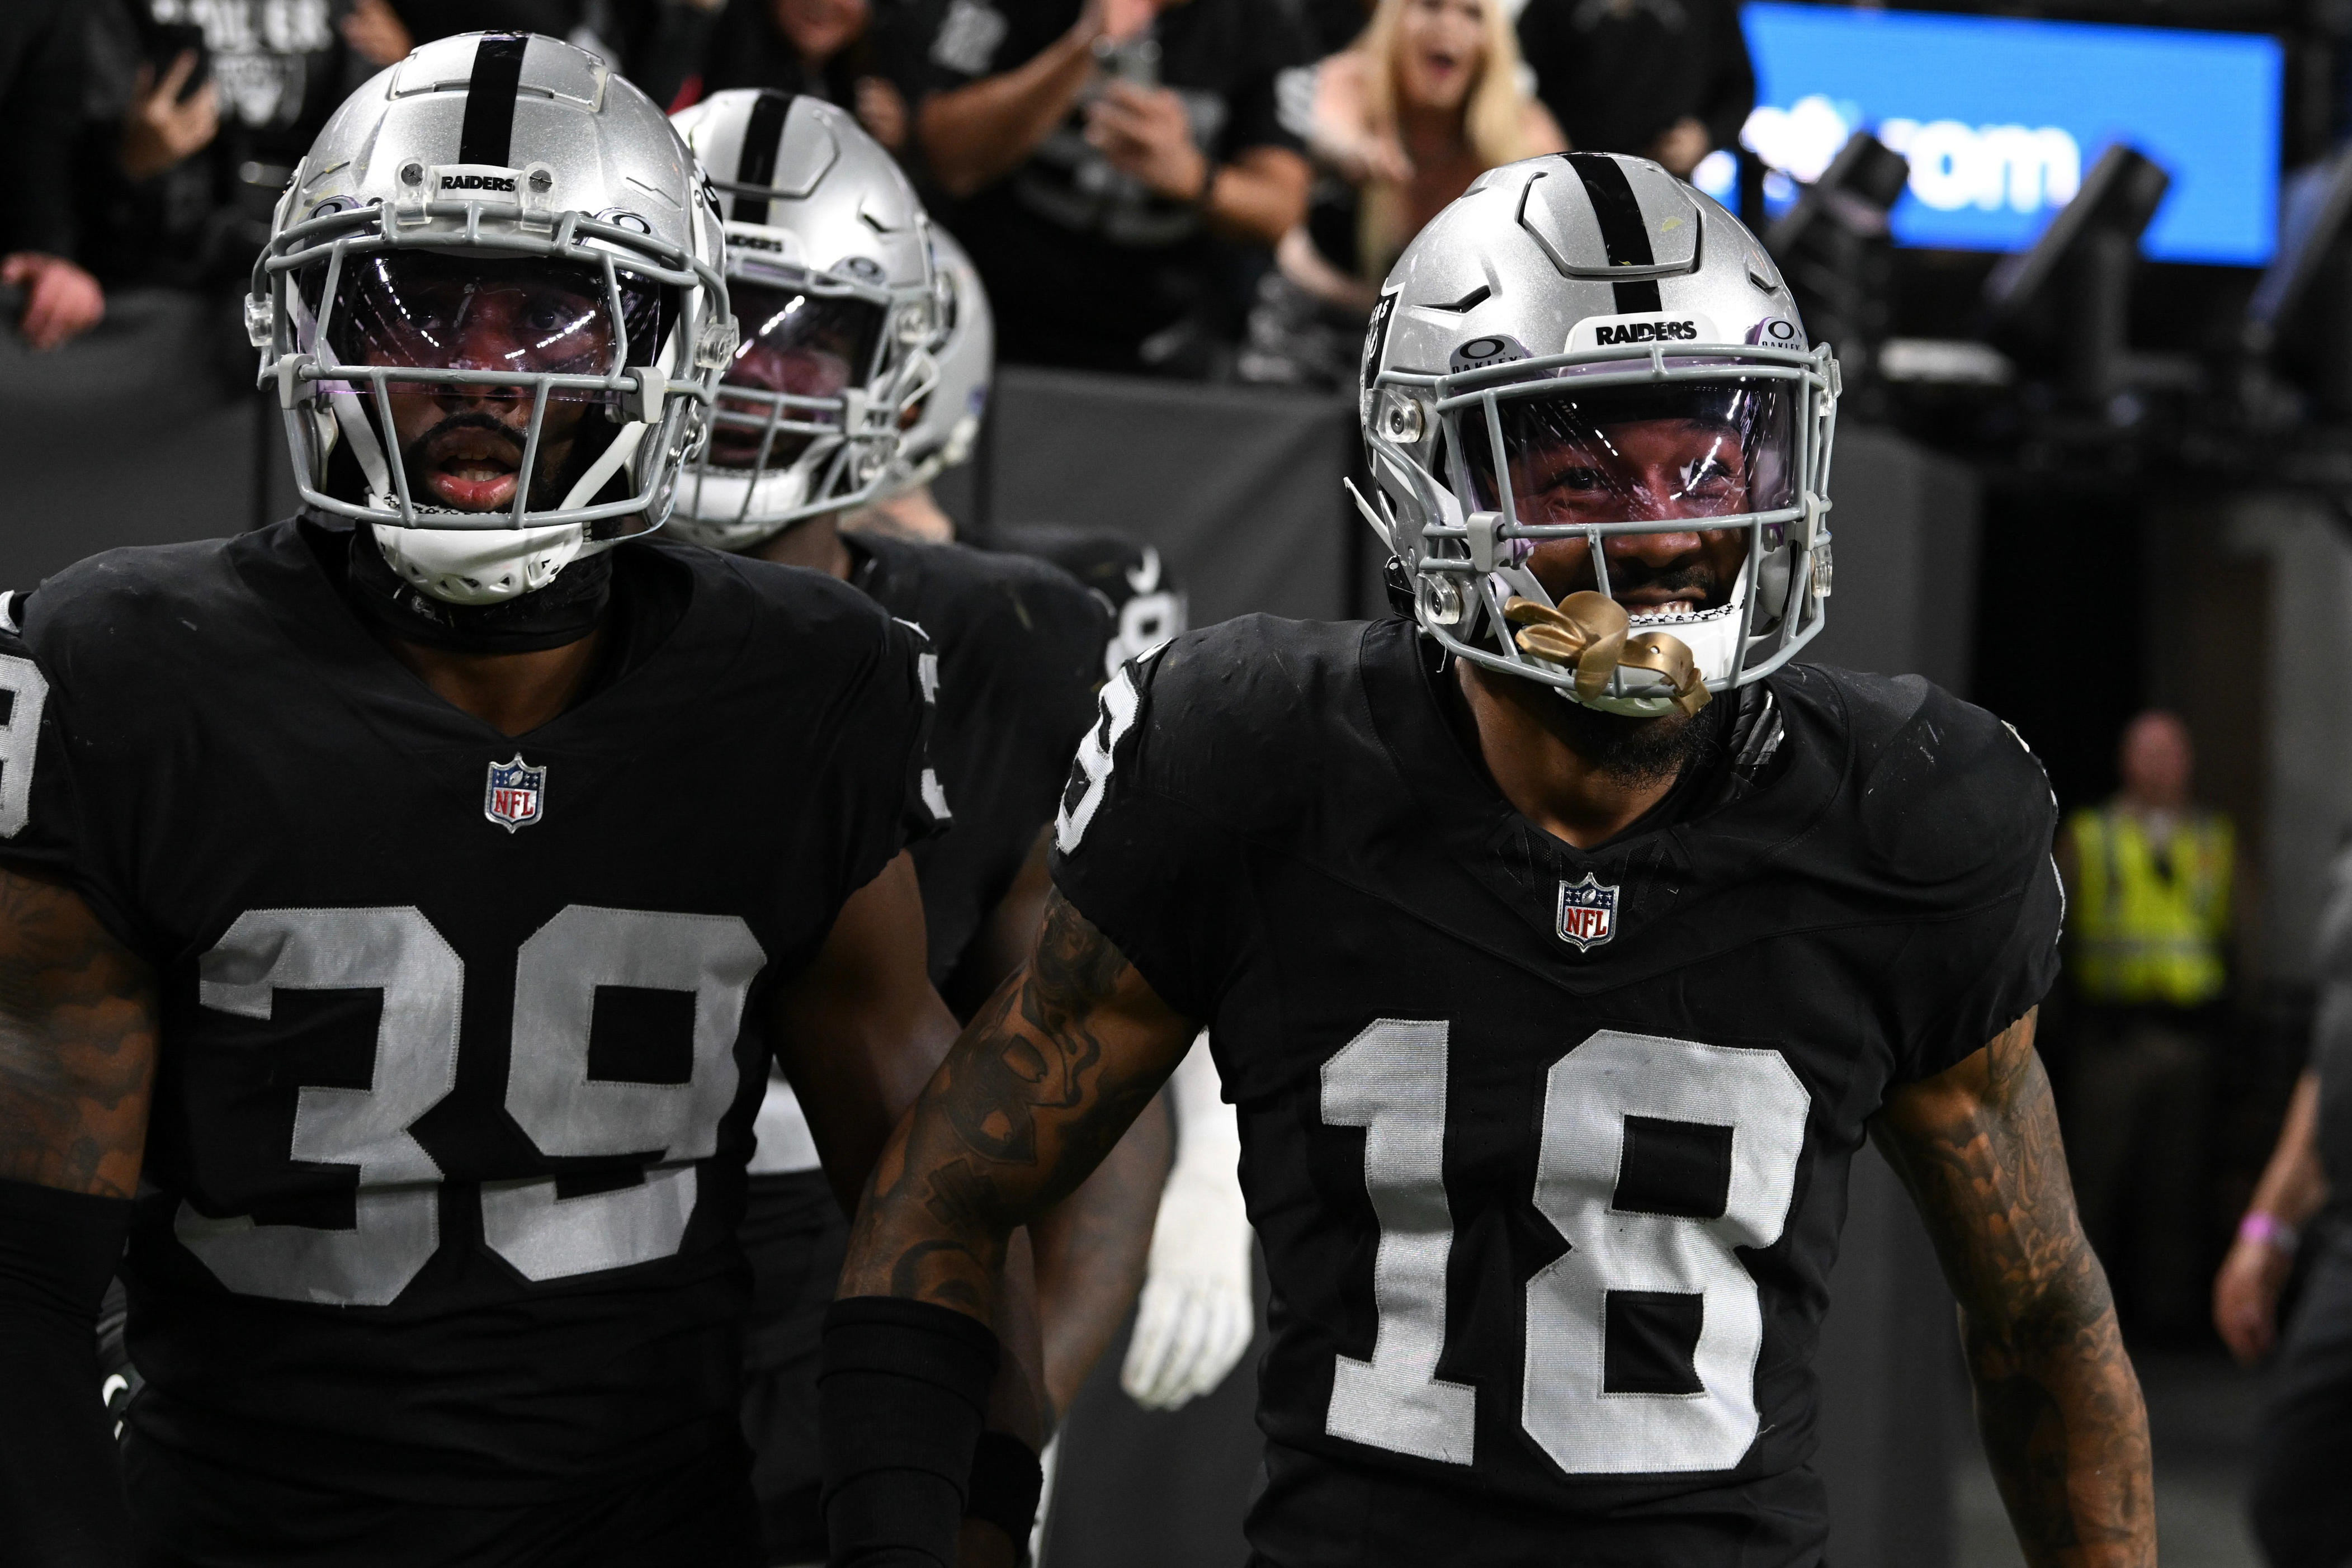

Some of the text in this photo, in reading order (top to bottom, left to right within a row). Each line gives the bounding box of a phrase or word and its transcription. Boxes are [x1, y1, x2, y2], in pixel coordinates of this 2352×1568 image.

[441, 176, 516, 192] RAIDERS
[1596, 321, 1697, 345] RAIDERS
[494, 790, 534, 819] NFL
[1566, 908, 1607, 939] NFL
[174, 904, 767, 1306] 39
[1320, 1018, 1811, 1474] 18
